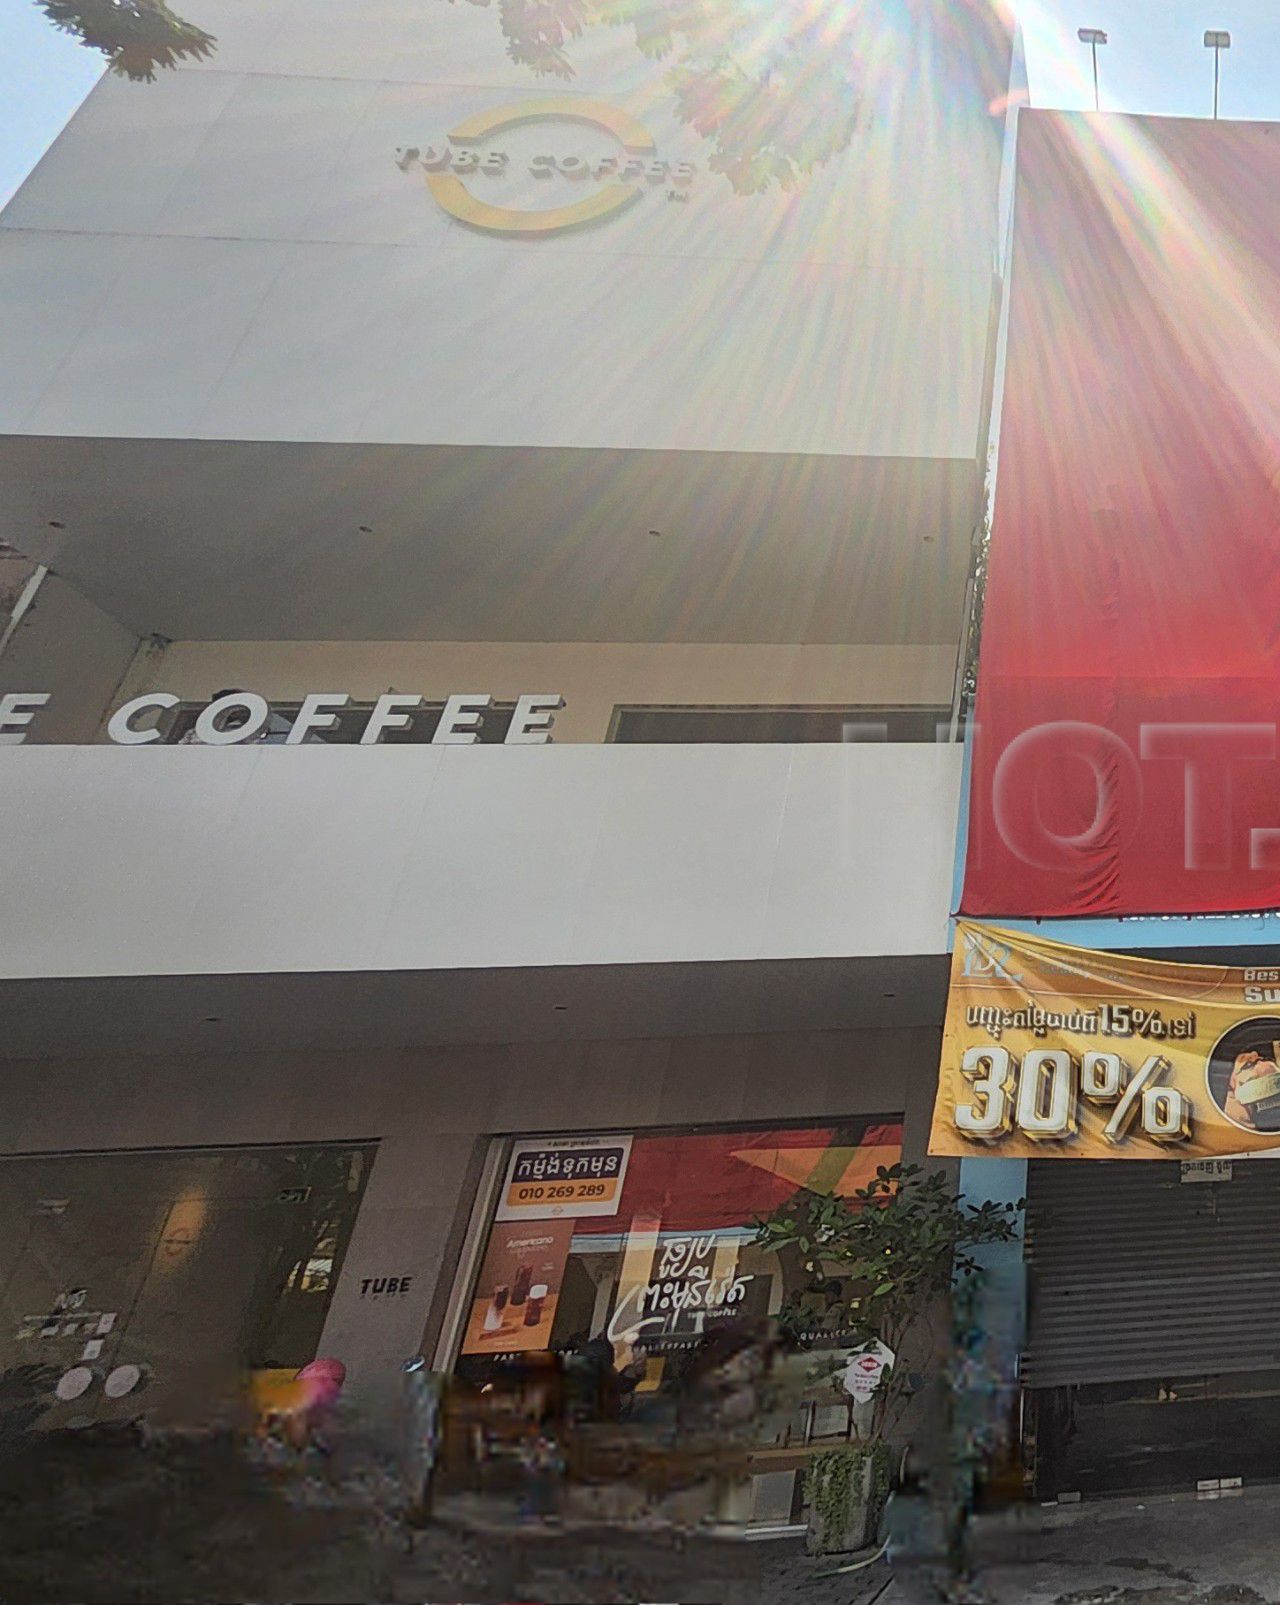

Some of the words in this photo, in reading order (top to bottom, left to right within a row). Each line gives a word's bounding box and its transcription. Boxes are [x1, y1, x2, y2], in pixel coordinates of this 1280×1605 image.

[395, 146, 509, 176] TUBE
[528, 153, 697, 185] COFFEE
[107, 692, 566, 745] COFFEE
[1098, 1003, 1165, 1038] 15%
[955, 1045, 1195, 1143] 30%
[518, 1187, 545, 1200] 010
[547, 1185, 574, 1199] 269
[577, 1184, 605, 1197] 289
[361, 1276, 413, 1294] TUBE
